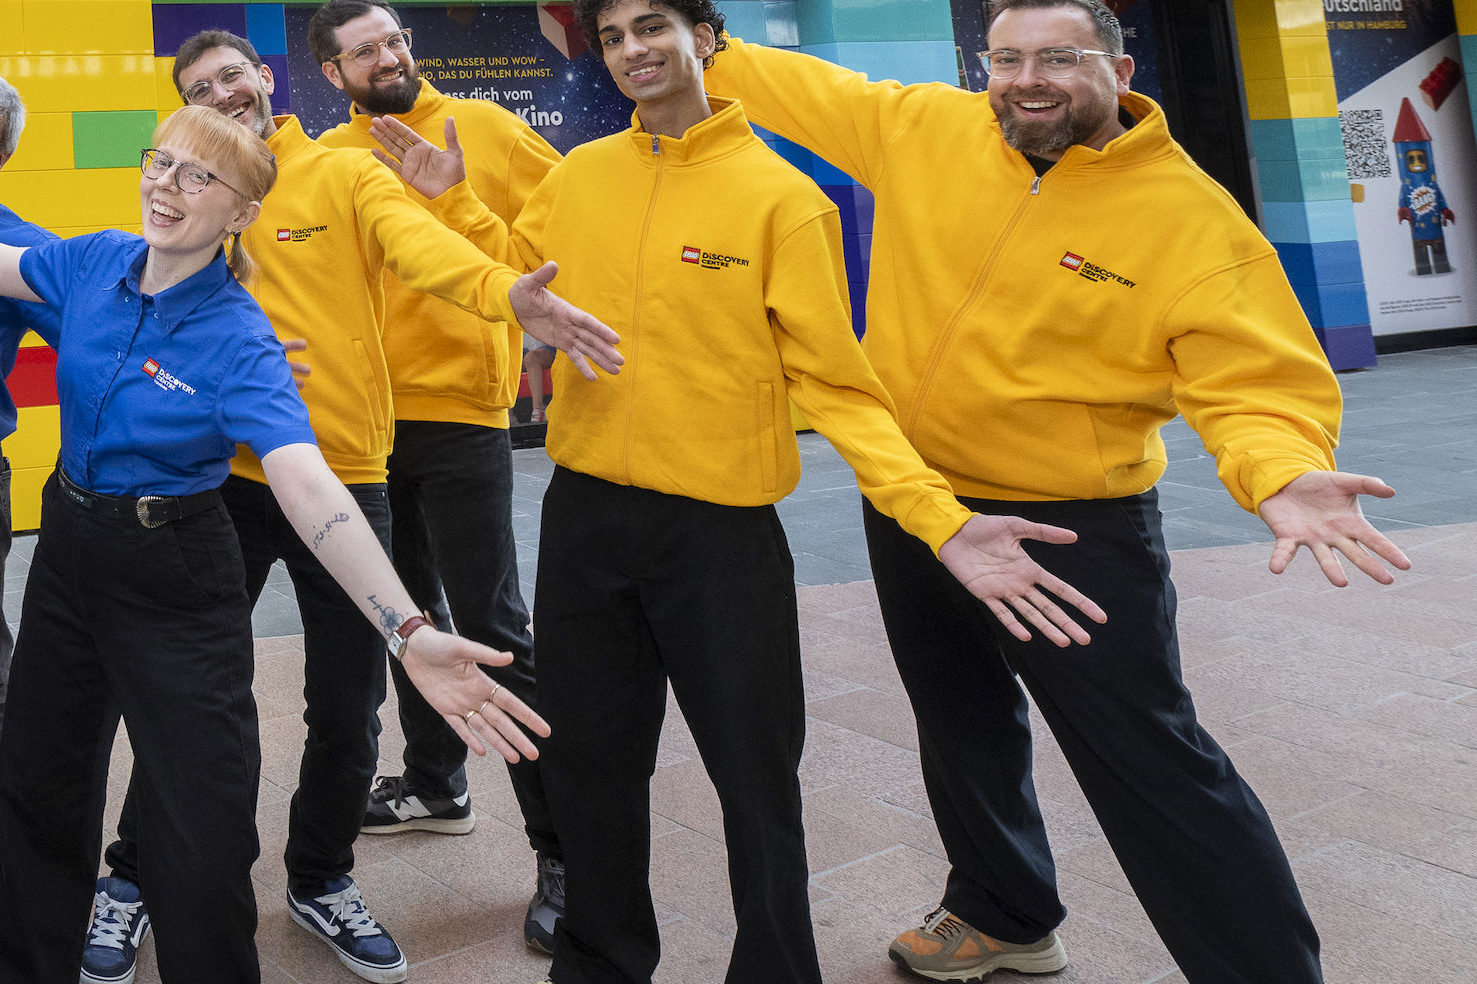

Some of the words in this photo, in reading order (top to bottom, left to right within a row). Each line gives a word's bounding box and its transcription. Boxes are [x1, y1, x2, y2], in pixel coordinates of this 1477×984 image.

[1356, 20, 1366, 30] IN
[1366, 19, 1407, 30] HAMBURG
[415, 58, 446, 68] WIND,
[447, 56, 486, 66] WASSER
[488, 56, 509, 66] UND
[510, 56, 537, 65] WOW
[438, 70, 457, 80] DAS
[459, 69, 473, 79] DU
[475, 67, 512, 79] FÜHLEN
[513, 68, 554, 78] KANNST.
[469, 86, 500, 101] dich
[503, 89, 533, 101] vom
